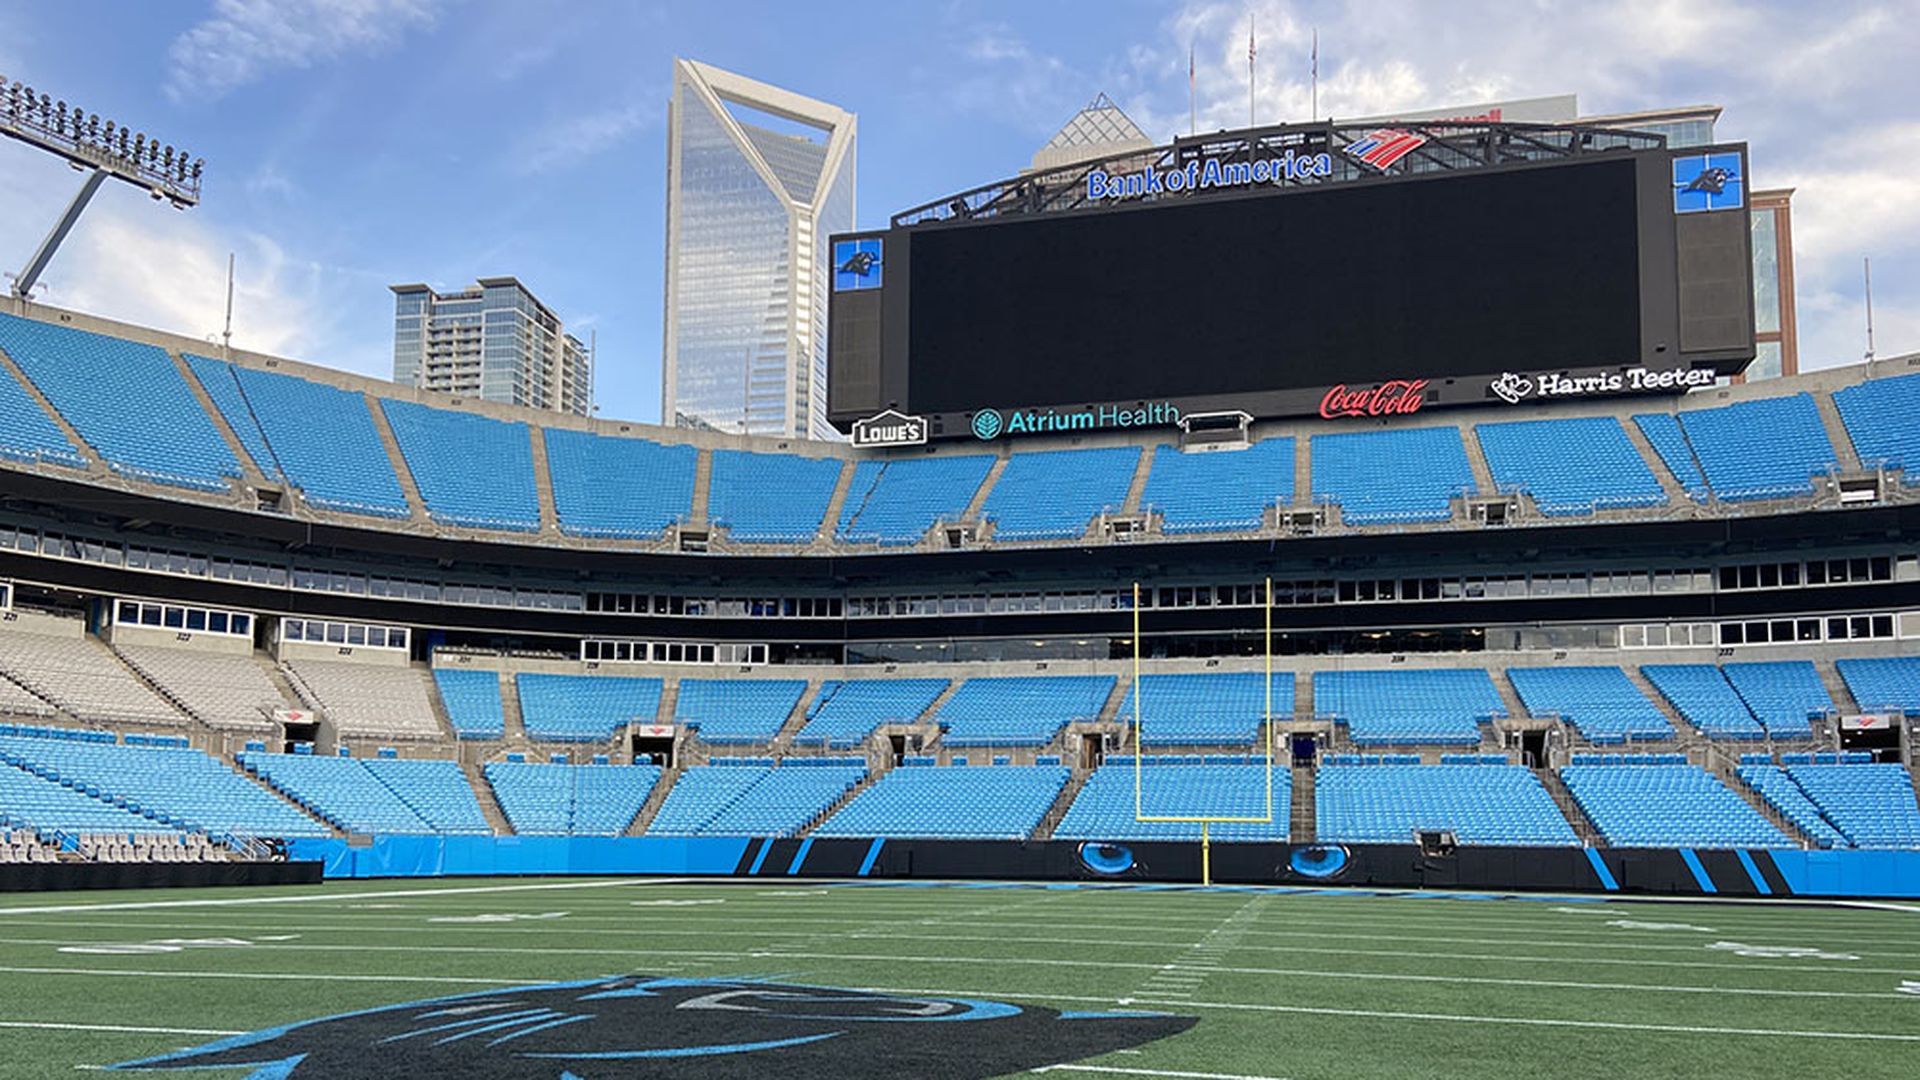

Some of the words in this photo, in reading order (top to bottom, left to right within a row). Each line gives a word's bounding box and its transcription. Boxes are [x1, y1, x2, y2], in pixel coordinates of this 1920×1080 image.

[1086, 165, 1165, 200] Bank
[1165, 160, 1199, 192] of
[1200, 149, 1332, 188] America
[1536, 370, 1622, 396] Harris
[1625, 367, 1718, 389] Teeter
[1319, 378, 1431, 420] Coca-Cola
[859, 421, 920, 444] LOWE'S
[1006, 409, 1095, 433] Atrium
[1098, 401, 1179, 426] Health
